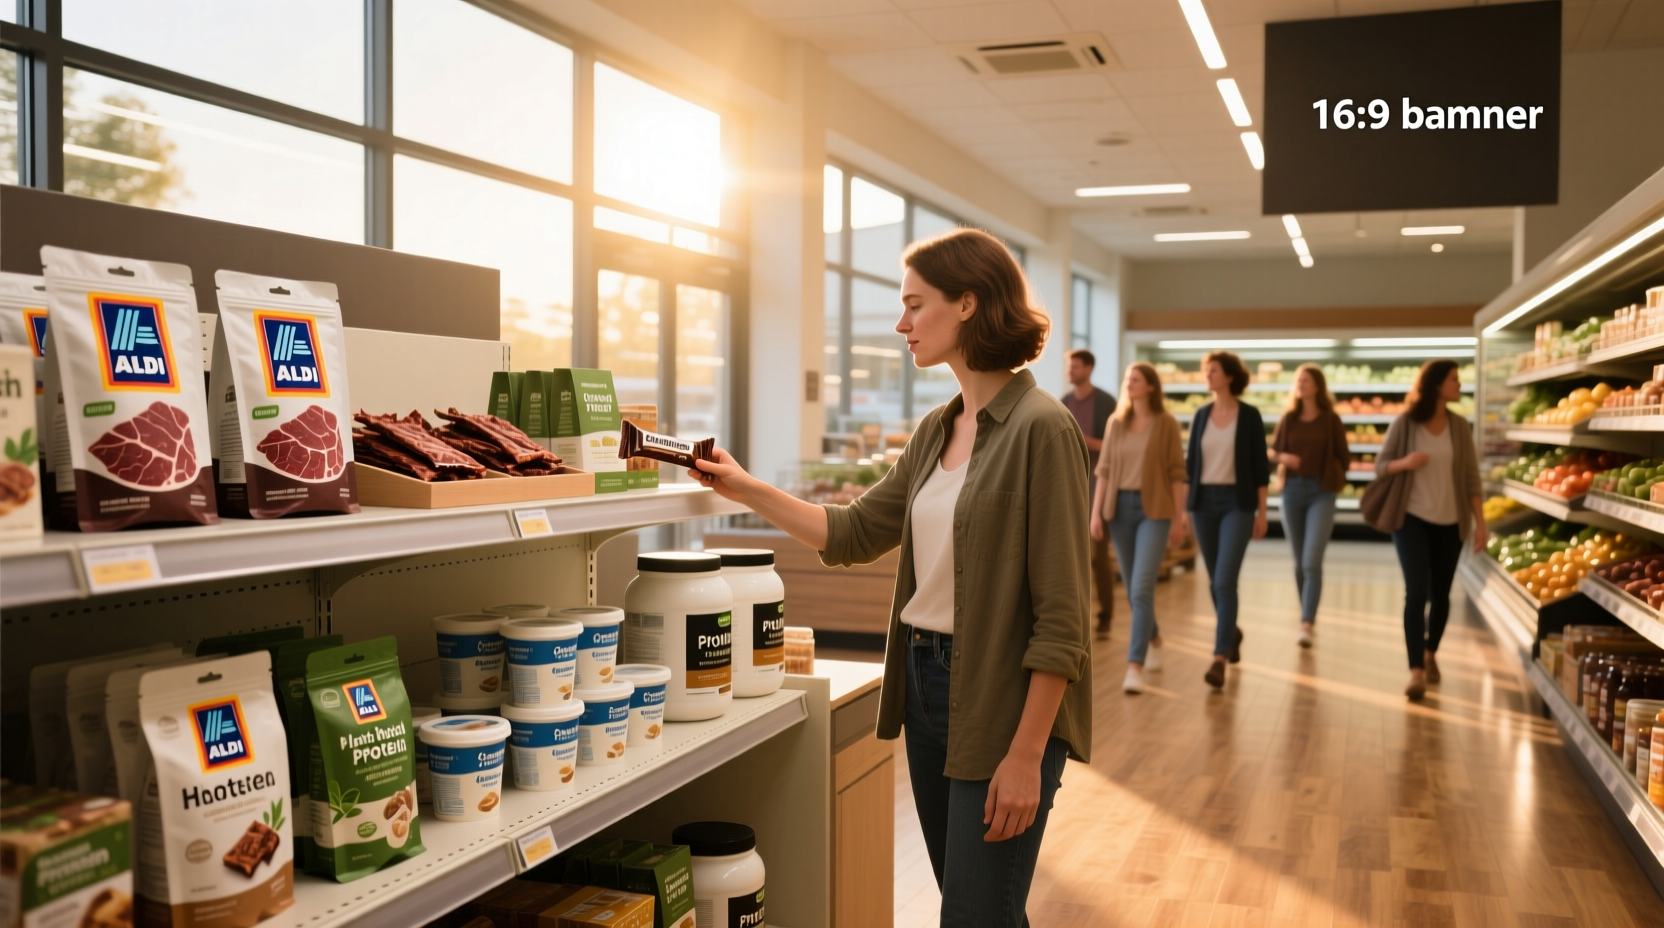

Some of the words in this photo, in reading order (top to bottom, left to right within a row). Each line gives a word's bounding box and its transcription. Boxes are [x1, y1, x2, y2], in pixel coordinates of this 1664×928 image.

[1312, 98, 1390, 130] 16:9
[1402, 97, 1544, 130] bamner
[115, 355, 165, 375] ALDI
[276, 365, 318, 382] ALDI
[209, 739, 244, 760] ALDI
